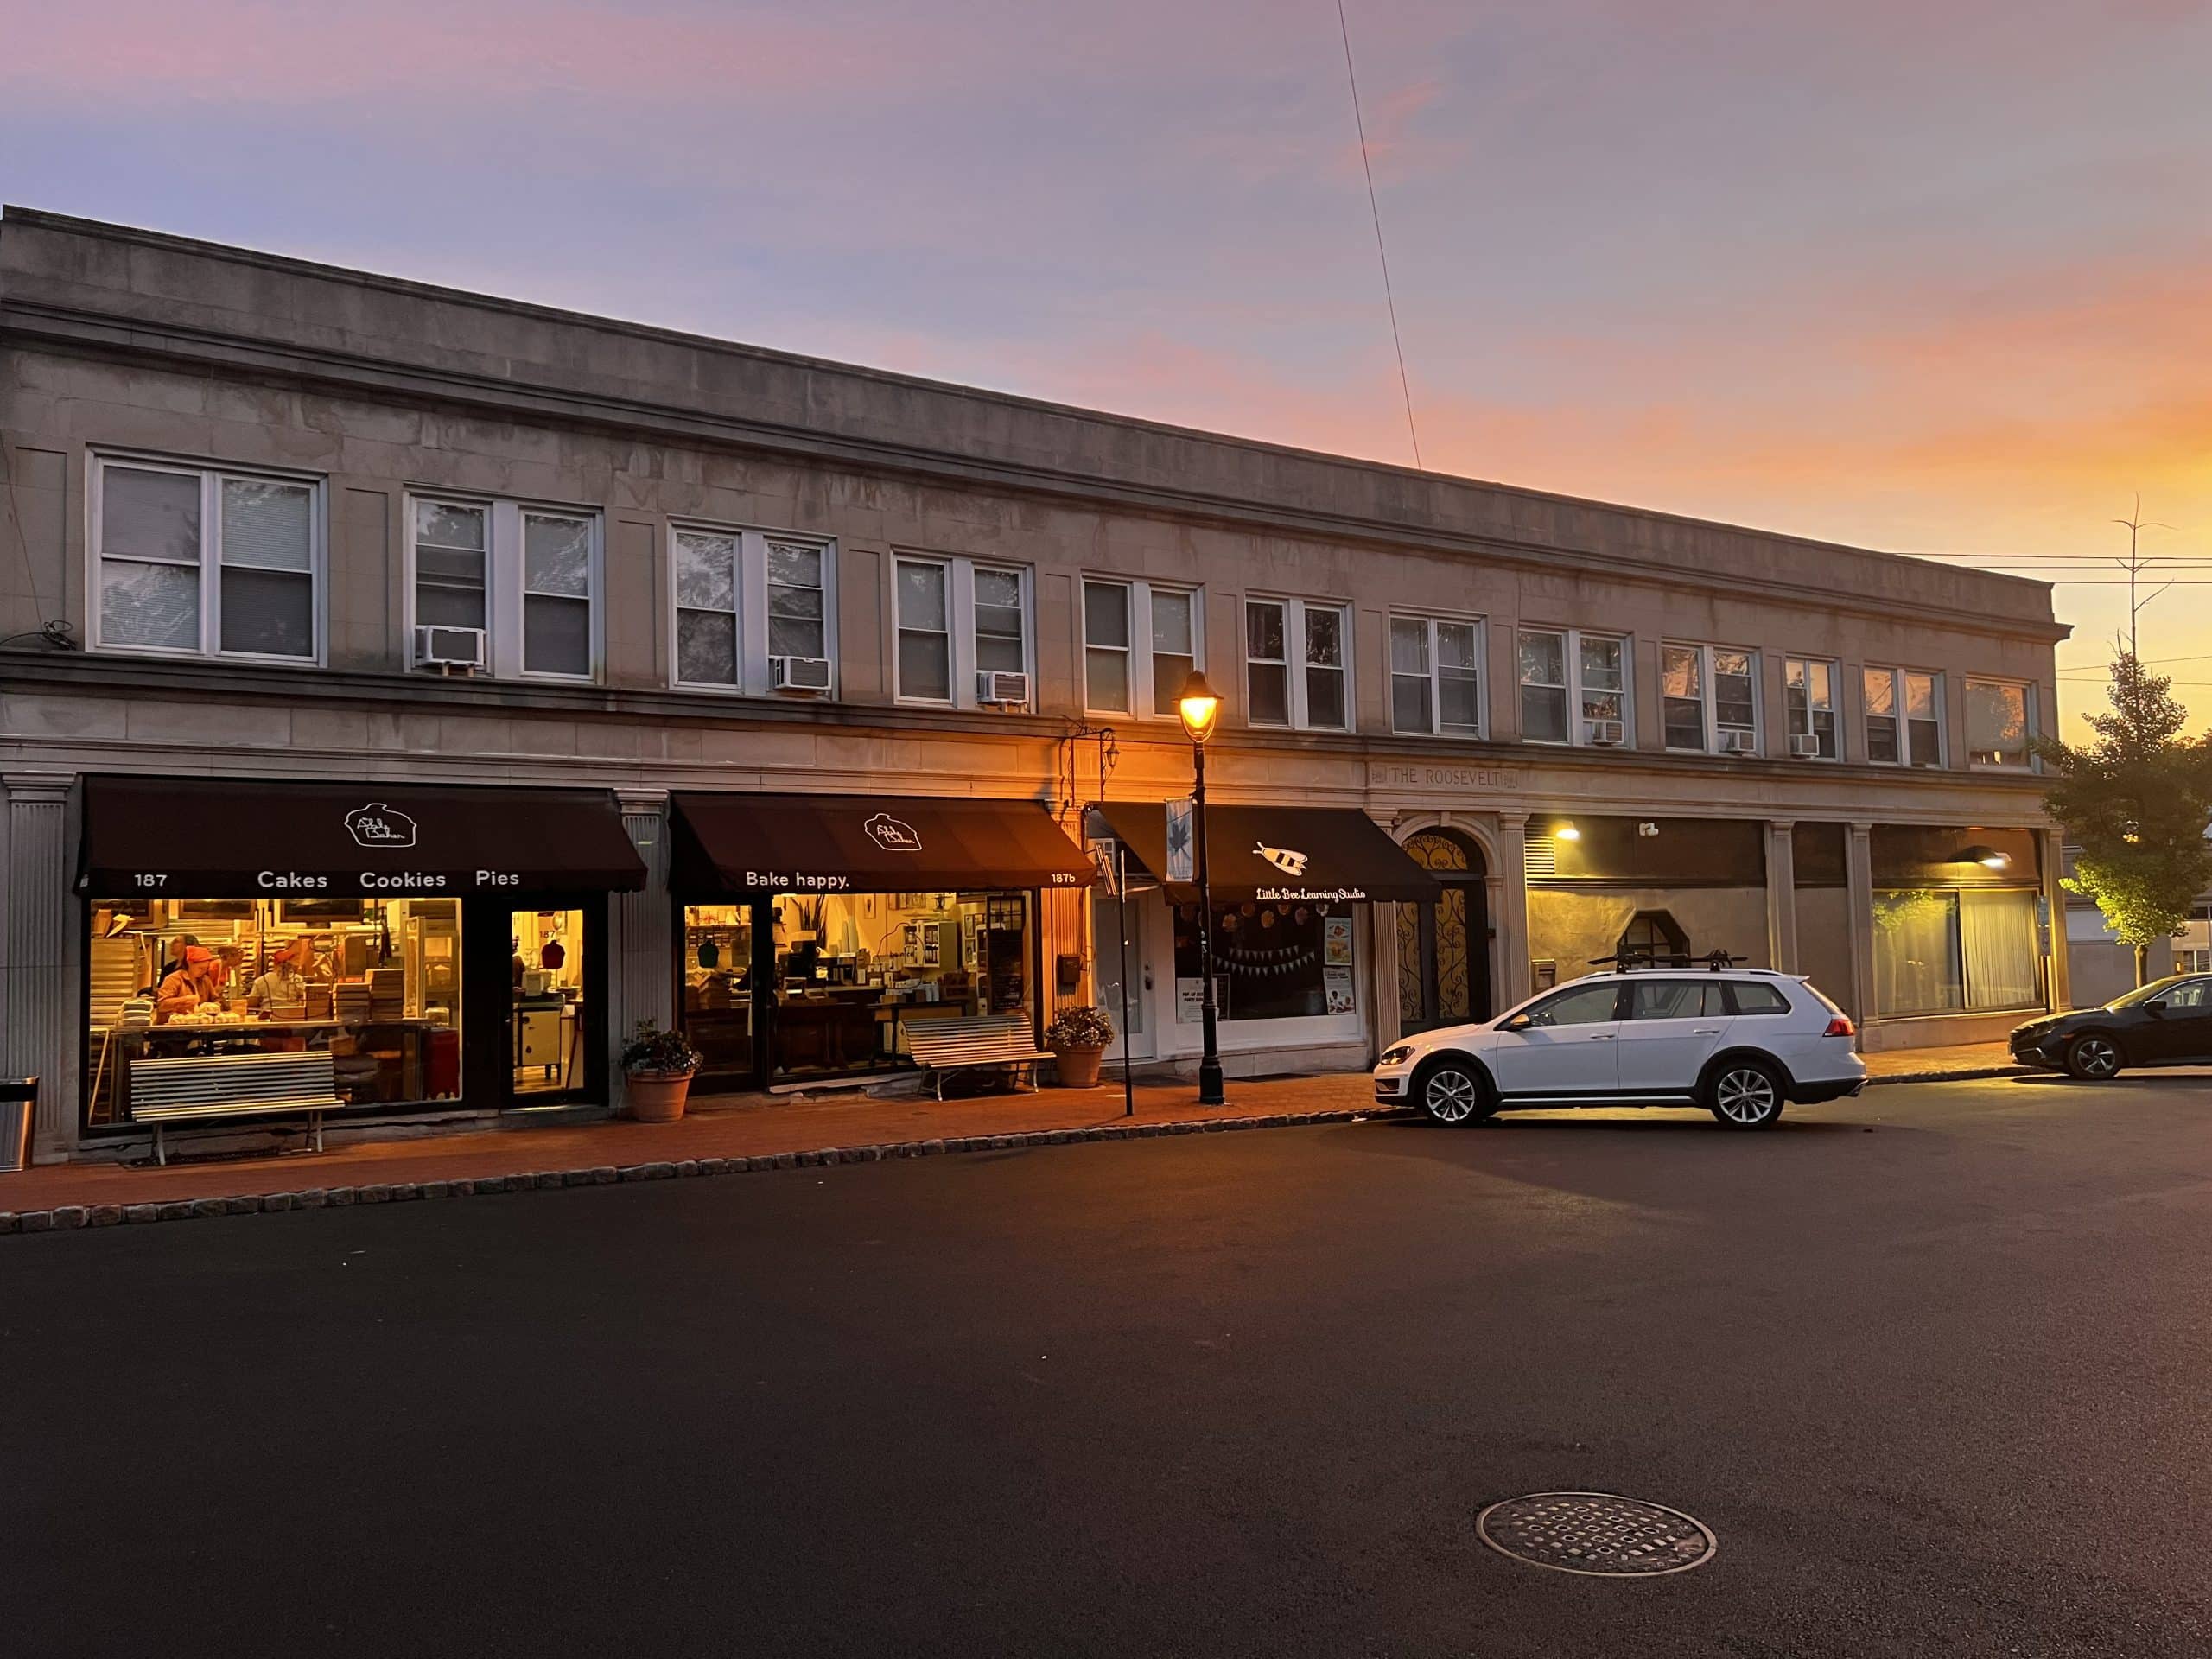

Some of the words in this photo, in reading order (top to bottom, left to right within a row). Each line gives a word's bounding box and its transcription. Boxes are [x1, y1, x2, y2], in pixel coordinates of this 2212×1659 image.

[1390, 767, 1418, 783] THE
[1426, 768, 1500, 787] ROOSEVELT
[134, 874, 168, 887] 187
[257, 871, 328, 888] Cakes
[359, 871, 446, 888] Cookies
[476, 870, 519, 886] Pies
[746, 871, 789, 887] Bake
[796, 871, 849, 890] happy.
[1051, 873, 1076, 883] 187b
[1256, 887, 1281, 899] Little
[1281, 887, 1300, 899] Bee
[1300, 887, 1339, 903] Learning
[1338, 888, 1366, 899] Studio
[539, 930, 556, 938] 187
